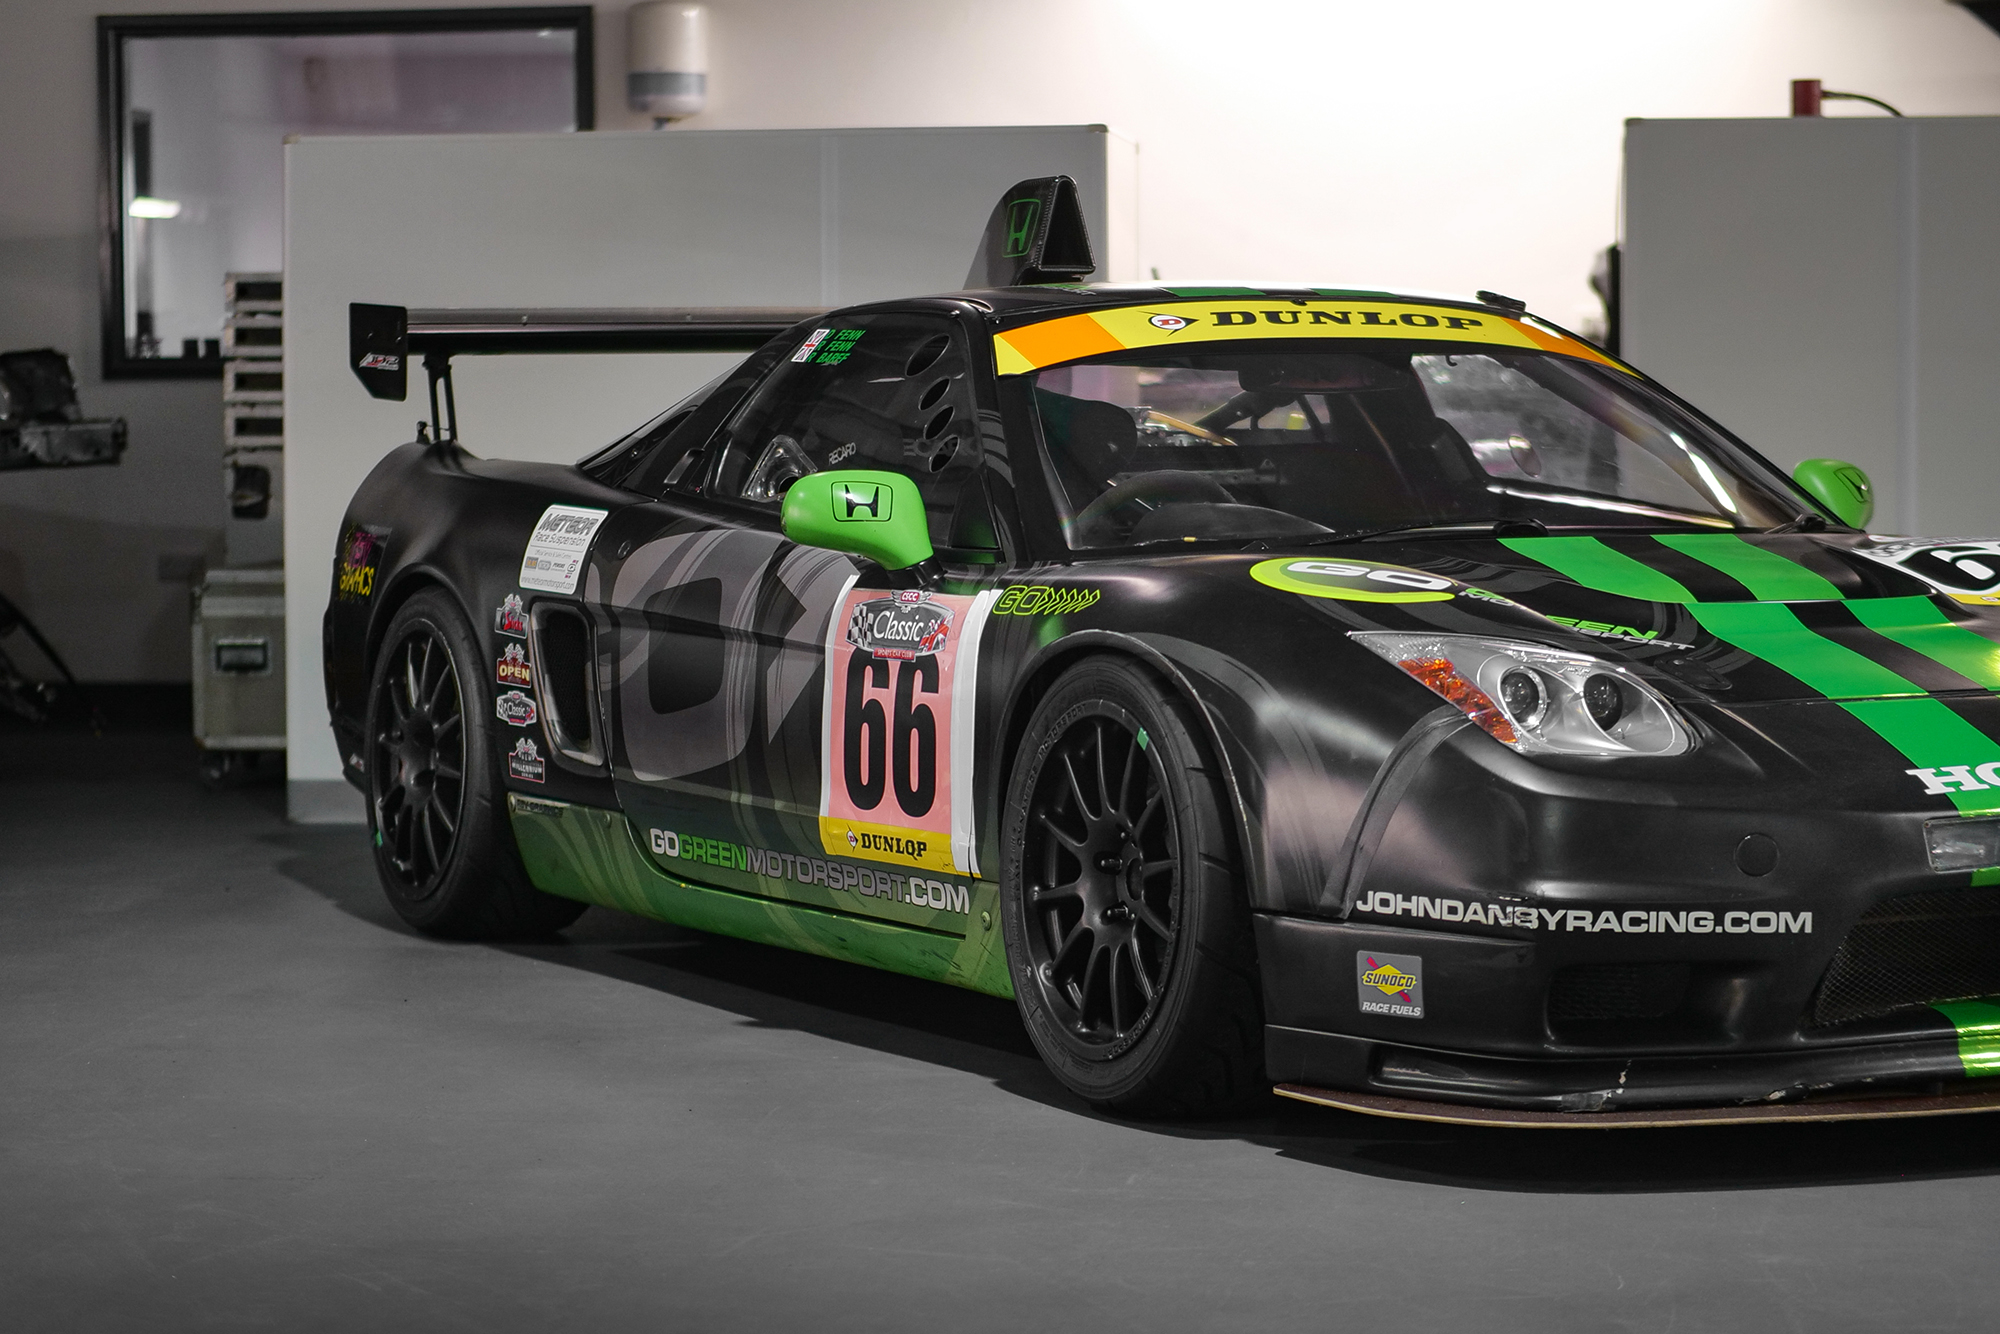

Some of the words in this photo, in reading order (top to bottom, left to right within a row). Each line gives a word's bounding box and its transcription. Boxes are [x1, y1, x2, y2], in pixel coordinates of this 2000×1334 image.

[1210, 311, 1484, 330] DUNLOP
[824, 329, 837, 340] D
[834, 329, 867, 340] FENN
[814, 340, 827, 351] R
[824, 340, 857, 352] FENN
[805, 352, 818, 363] R
[828, 442, 857, 465] RECARO
[538, 513, 600, 536] METEOR
[901, 592, 919, 601] CSCC
[873, 609, 925, 642] Classic
[499, 664, 531, 682] OPEN
[507, 701, 527, 717] Classic
[844, 646, 940, 818] 66
[860, 832, 928, 858] DUNLOP
[649, 827, 971, 915] GOGREENMOTORSPORT.COM
[1356, 890, 1813, 934] JOHNDANBYRACING.COM
[1364, 972, 1415, 988] SUNOCO
[1361, 1001, 1391, 1013] RACE
[1390, 1004, 1422, 1017] FUELS
